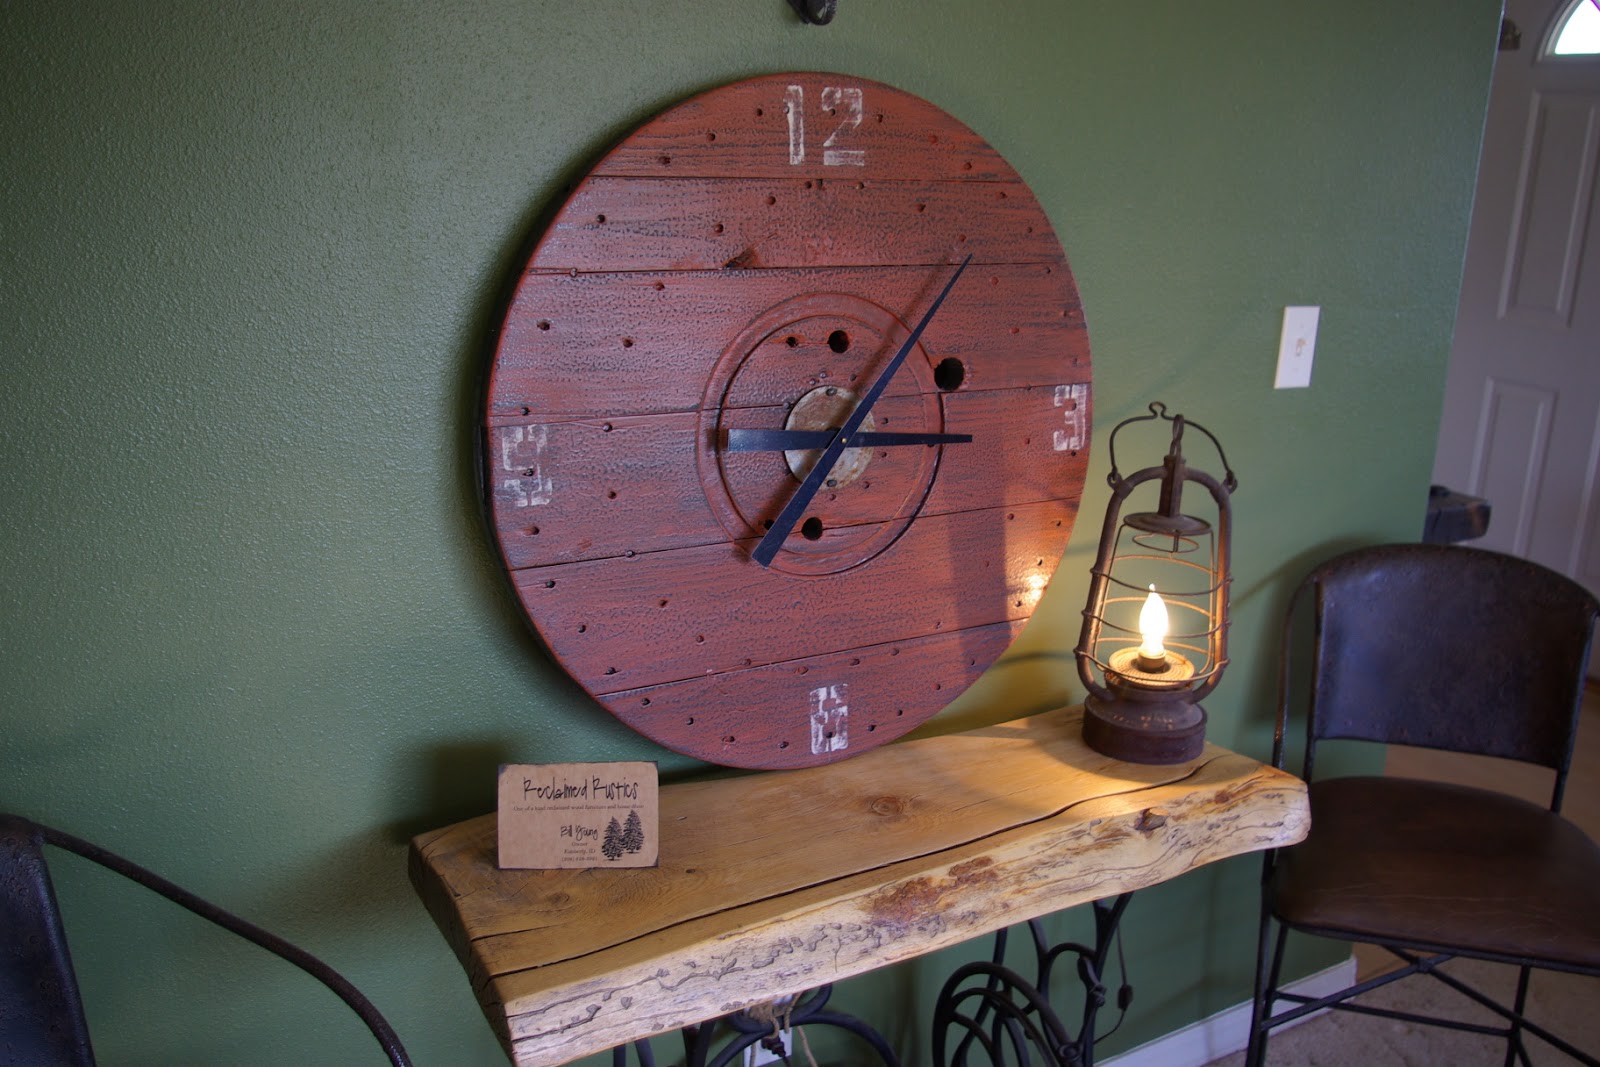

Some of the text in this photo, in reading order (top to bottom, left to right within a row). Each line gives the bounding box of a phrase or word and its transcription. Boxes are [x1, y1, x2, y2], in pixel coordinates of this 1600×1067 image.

[782, 84, 865, 167] 12
[1053, 384, 1087, 451] 3
[501, 425, 553, 507] 9
[809, 683, 849, 755] 6
[523, 775, 639, 801] Reclaimed Rustics
[560, 824, 599, 842] Bill Young
